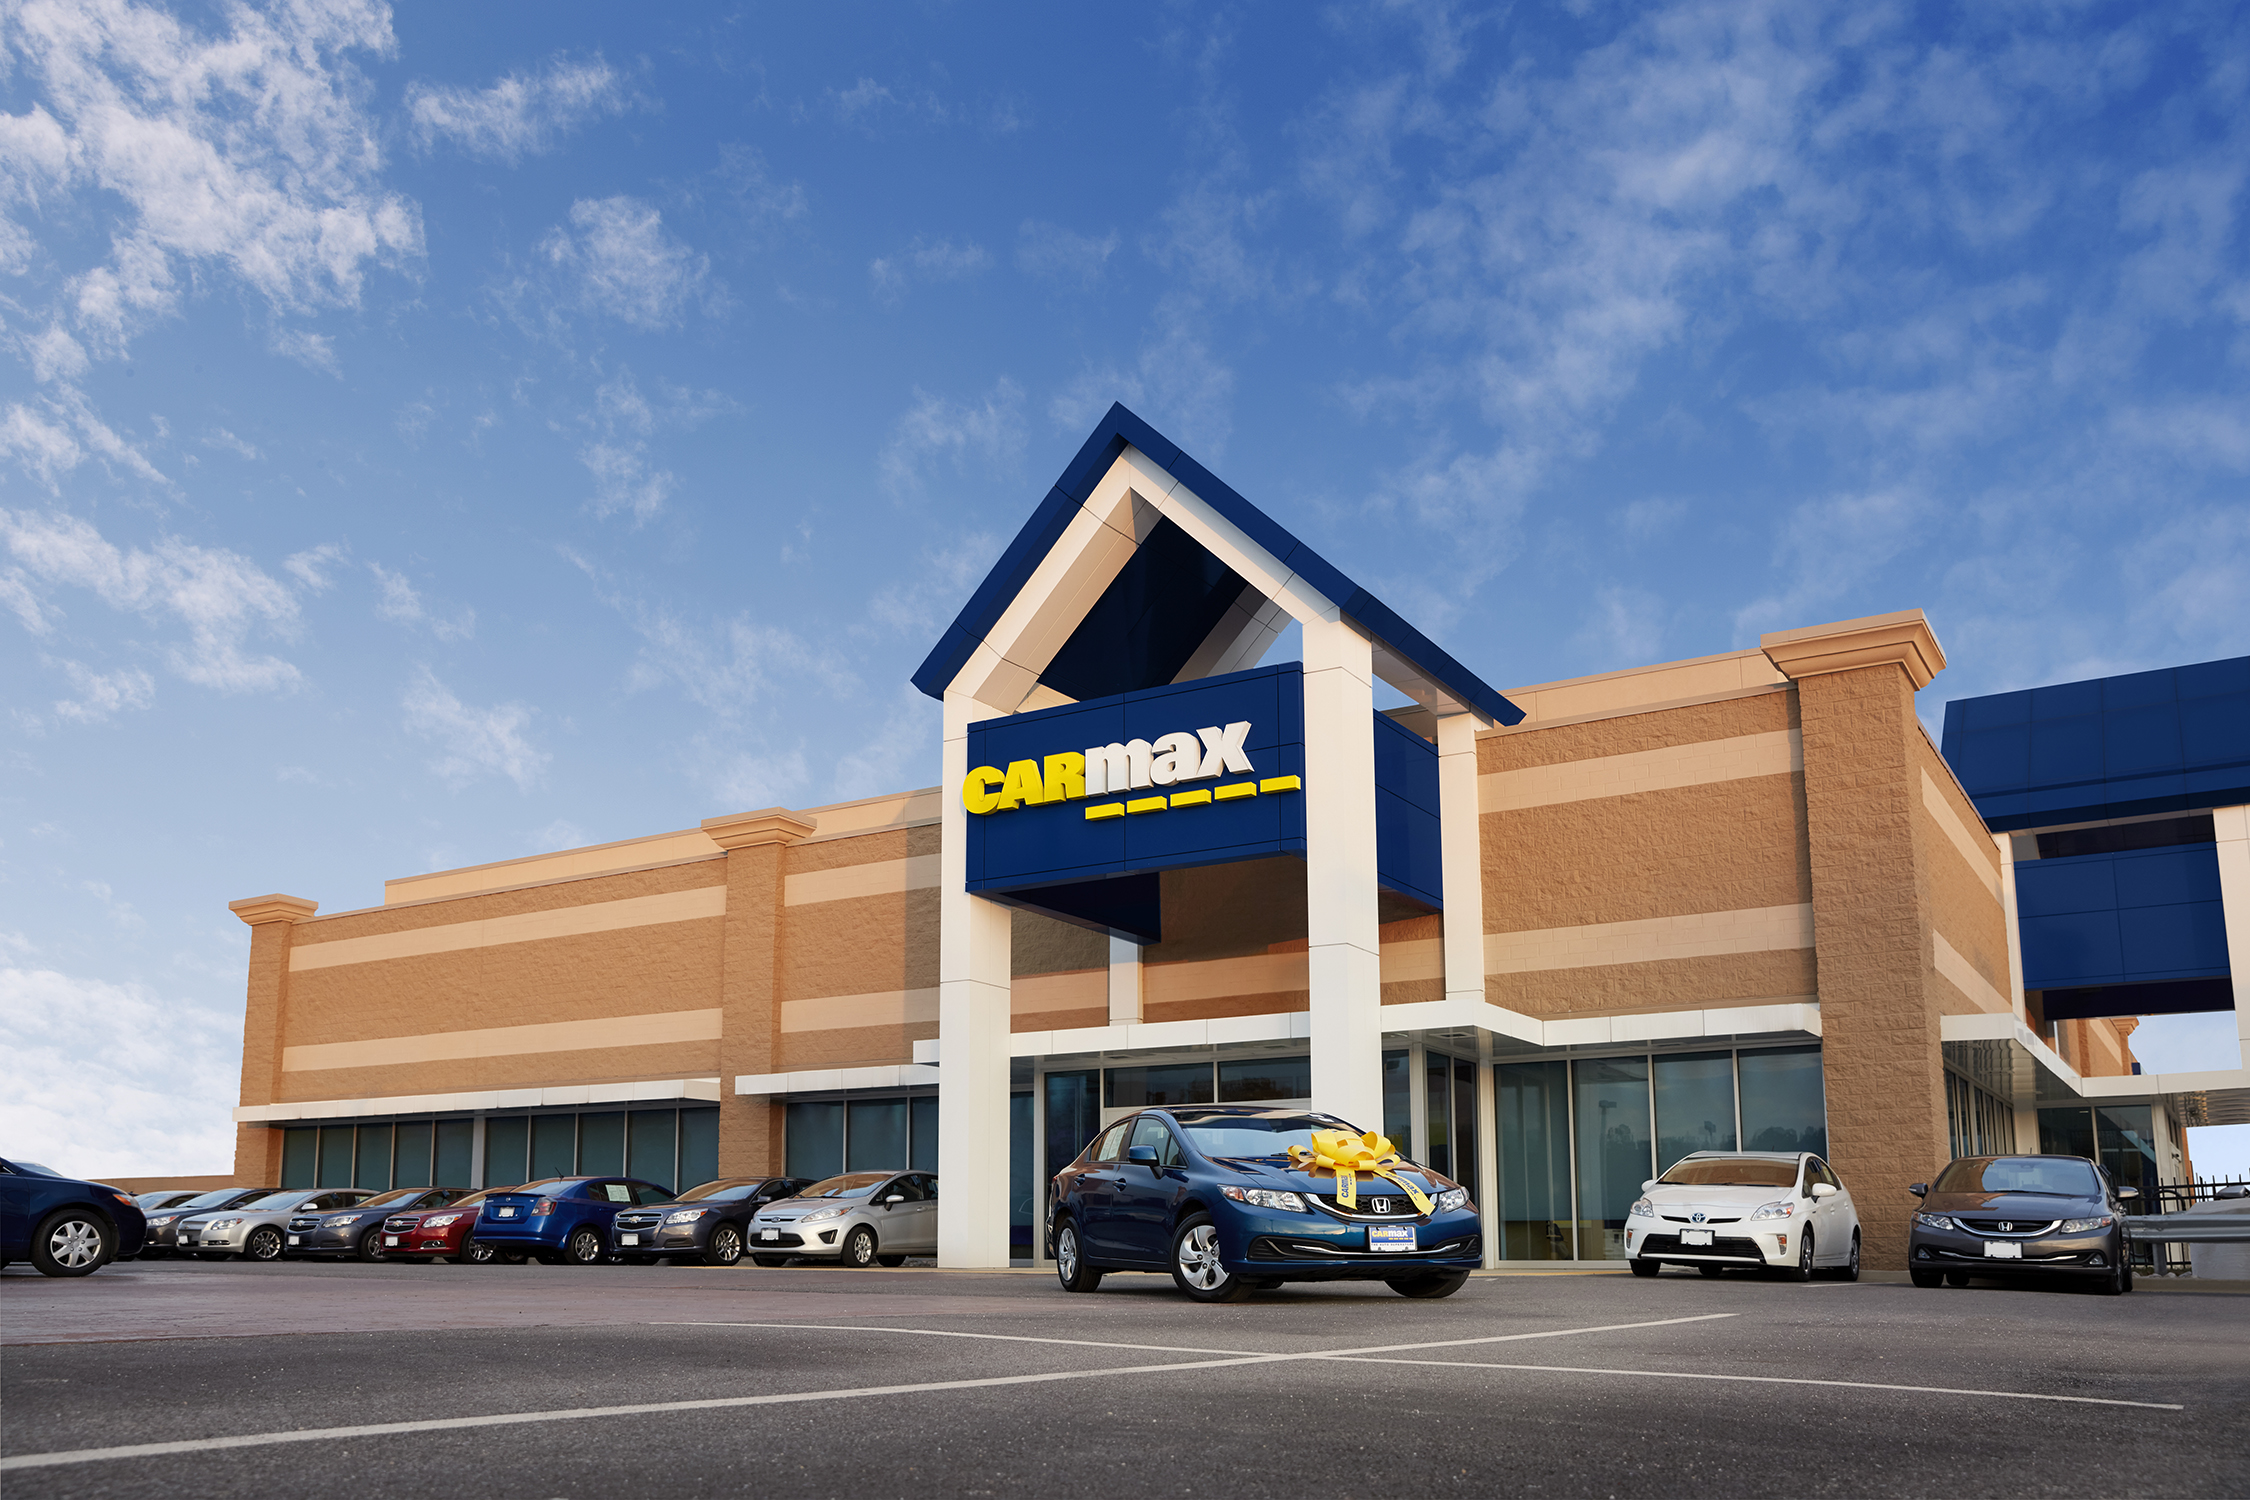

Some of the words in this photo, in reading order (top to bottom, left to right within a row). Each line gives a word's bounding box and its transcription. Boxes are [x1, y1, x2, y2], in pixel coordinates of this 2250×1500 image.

[962, 720, 1254, 815] CARmax
[1341, 1174, 1349, 1198] CARma
[1371, 1230, 1408, 1238] CARmax
